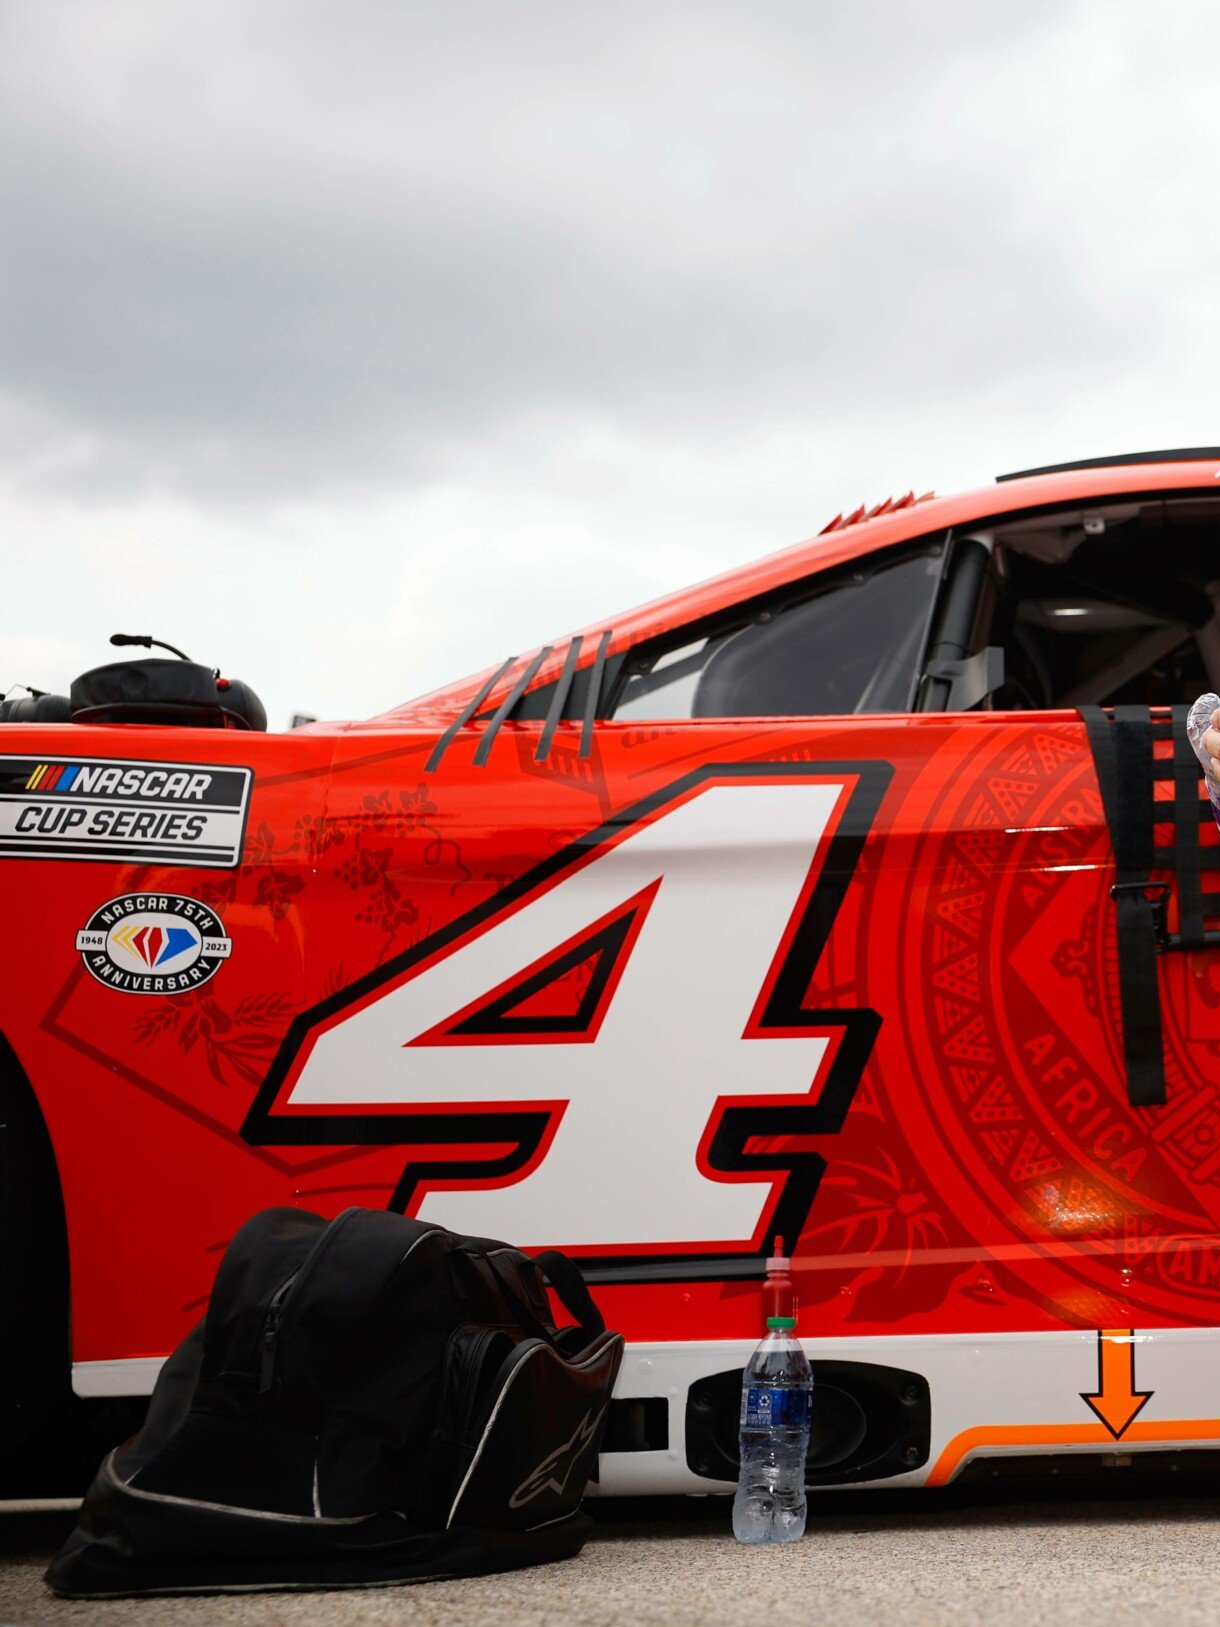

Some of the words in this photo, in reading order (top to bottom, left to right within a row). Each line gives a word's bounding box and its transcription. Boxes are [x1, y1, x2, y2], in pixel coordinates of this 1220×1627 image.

[70, 766, 213, 800] NASCAR
[15, 806, 88, 835] CUP
[87, 810, 208, 841] SERIES
[101, 897, 168, 924] NASCAR
[175, 900, 214, 930] 75TH
[81, 936, 103, 945] 1948
[205, 942, 228, 951] 2023
[92, 955, 211, 991] ANNIVERSARY
[255, 768, 872, 1262] 4
[1024, 1033, 1148, 1182] AFRICA
